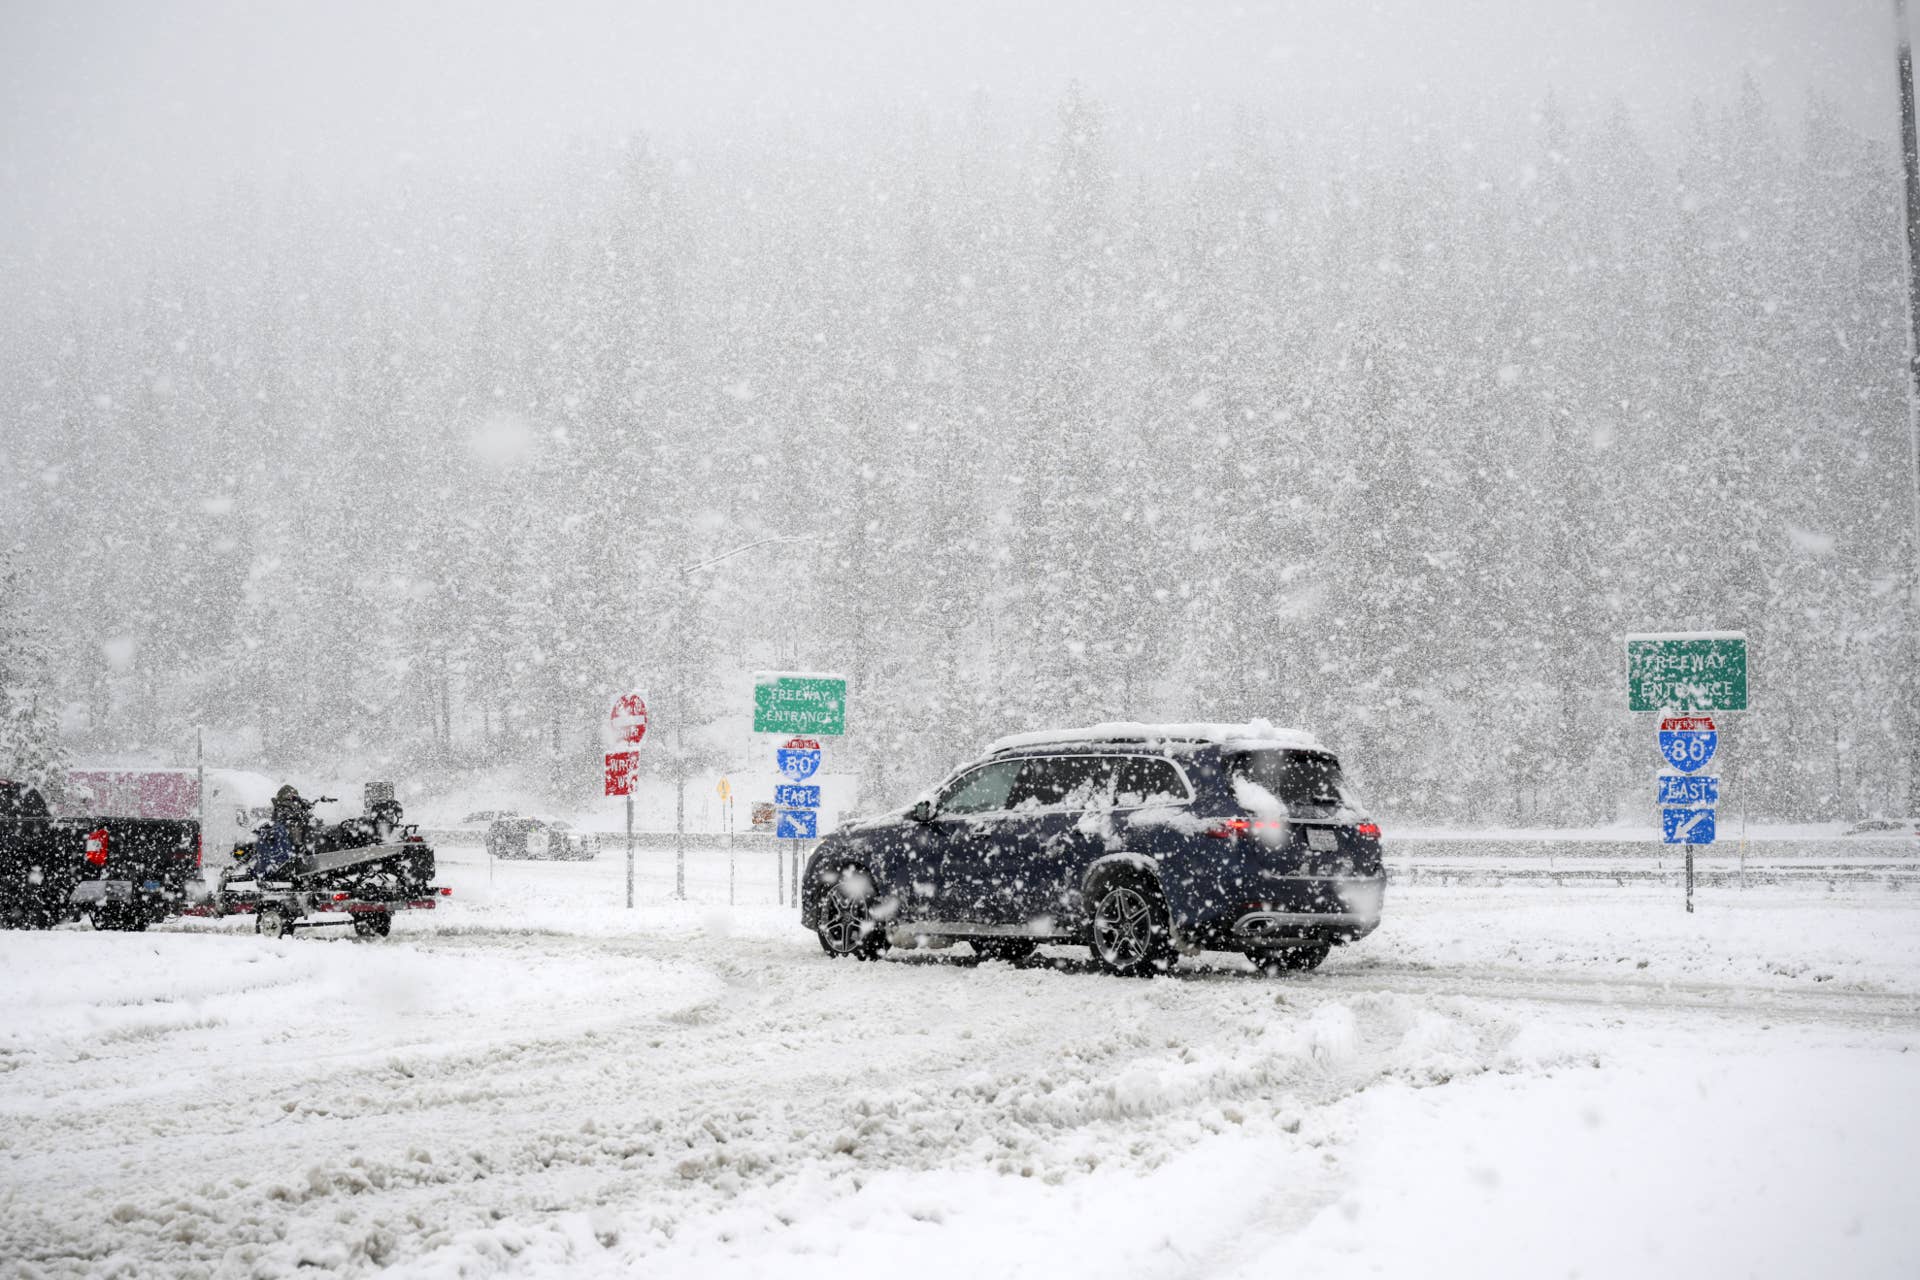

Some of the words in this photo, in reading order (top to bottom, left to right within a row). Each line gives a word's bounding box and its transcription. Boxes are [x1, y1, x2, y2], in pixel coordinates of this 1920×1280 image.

[1645, 655, 1727, 669] FREEWAY
[771, 688, 829, 701] FREEWAY
[766, 710, 832, 722] ENTRANCE
[1672, 739, 1705, 761] 80
[786, 756, 811, 774] 80
[783, 788, 813, 804] EAST
[1668, 782, 1708, 799] EAST
